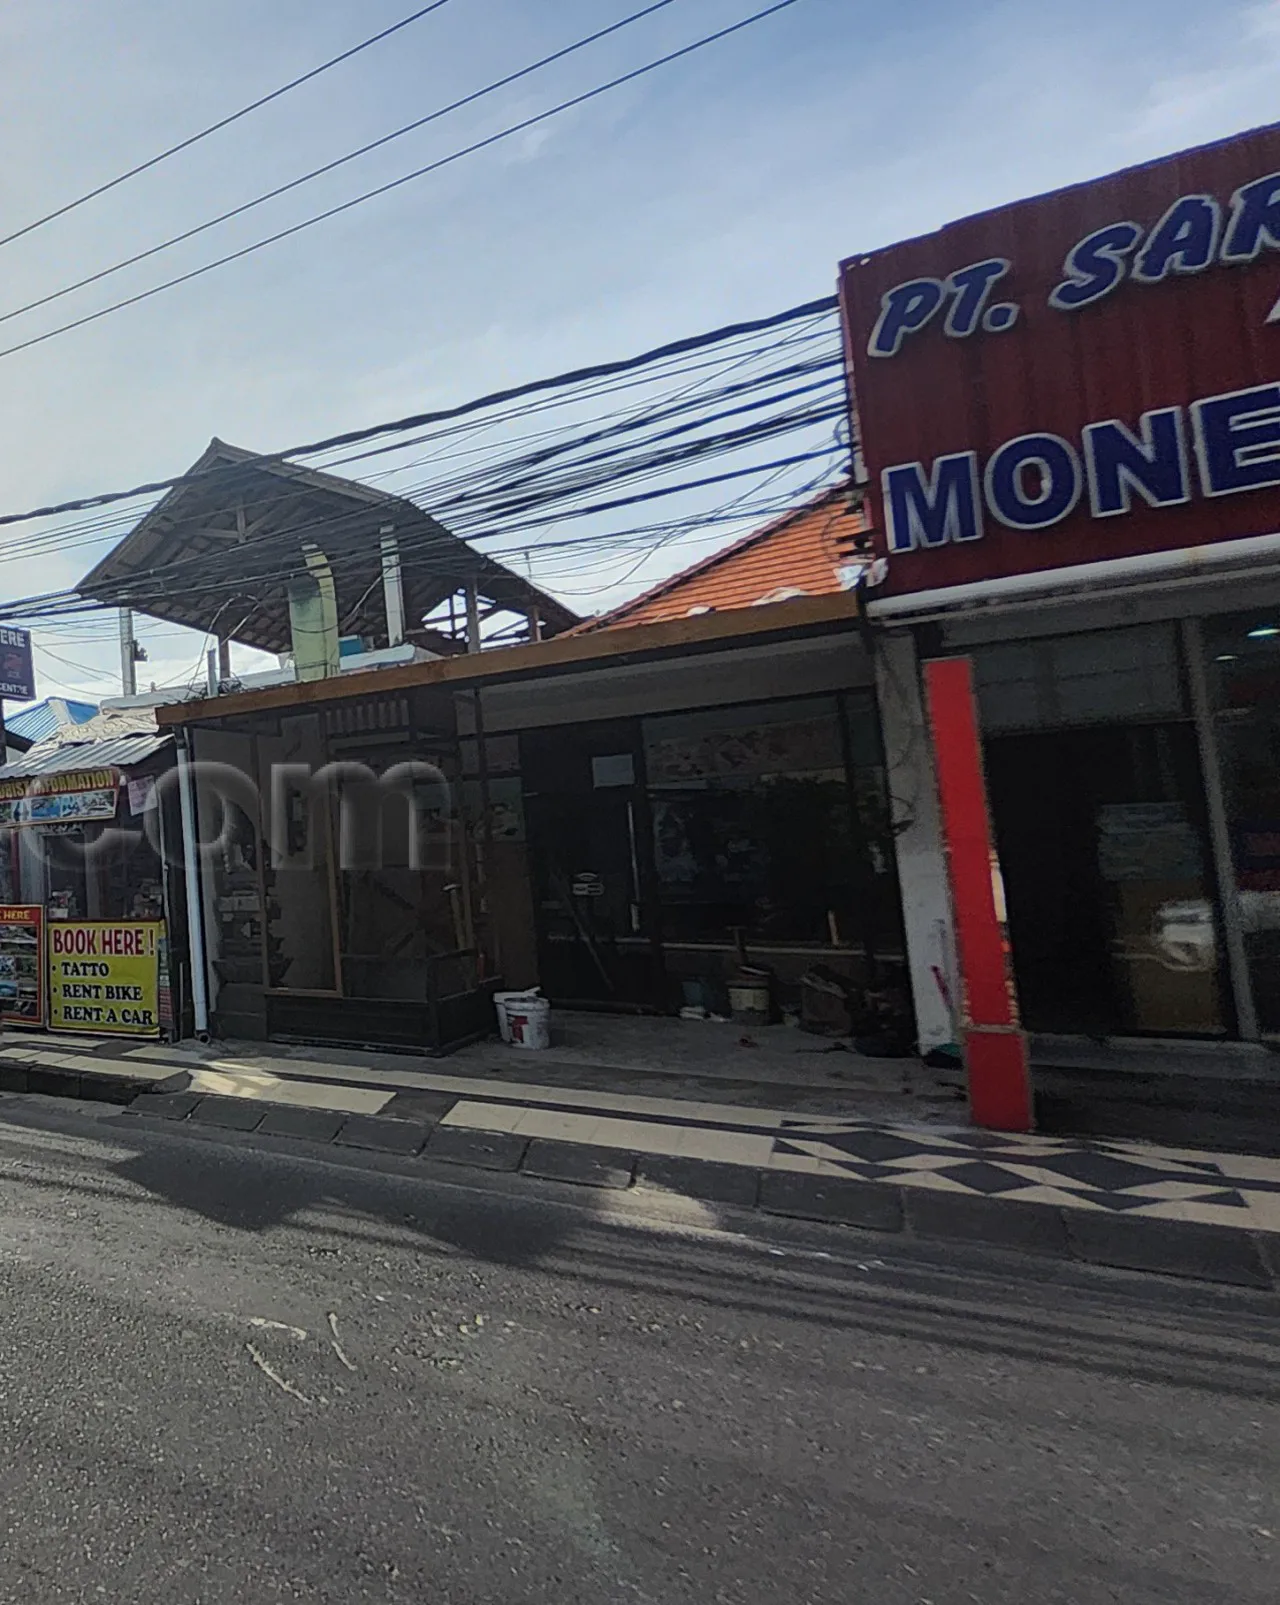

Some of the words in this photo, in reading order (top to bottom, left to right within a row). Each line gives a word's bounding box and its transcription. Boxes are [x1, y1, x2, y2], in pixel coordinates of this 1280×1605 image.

[867, 257, 1021, 358] PT.
[881, 382, 1280, 554] MONE
[3, 910, 31, 920] HERE
[53, 929, 96, 955] BOOK
[101, 929, 145, 956] HERE
[61, 962, 110, 977] TATTO
[63, 984, 102, 999] RENT
[105, 986, 143, 1001] BIKE
[64, 1006, 103, 1022] RENT
[106, 1008, 118, 1022] A
[122, 1009, 153, 1025] CAR
